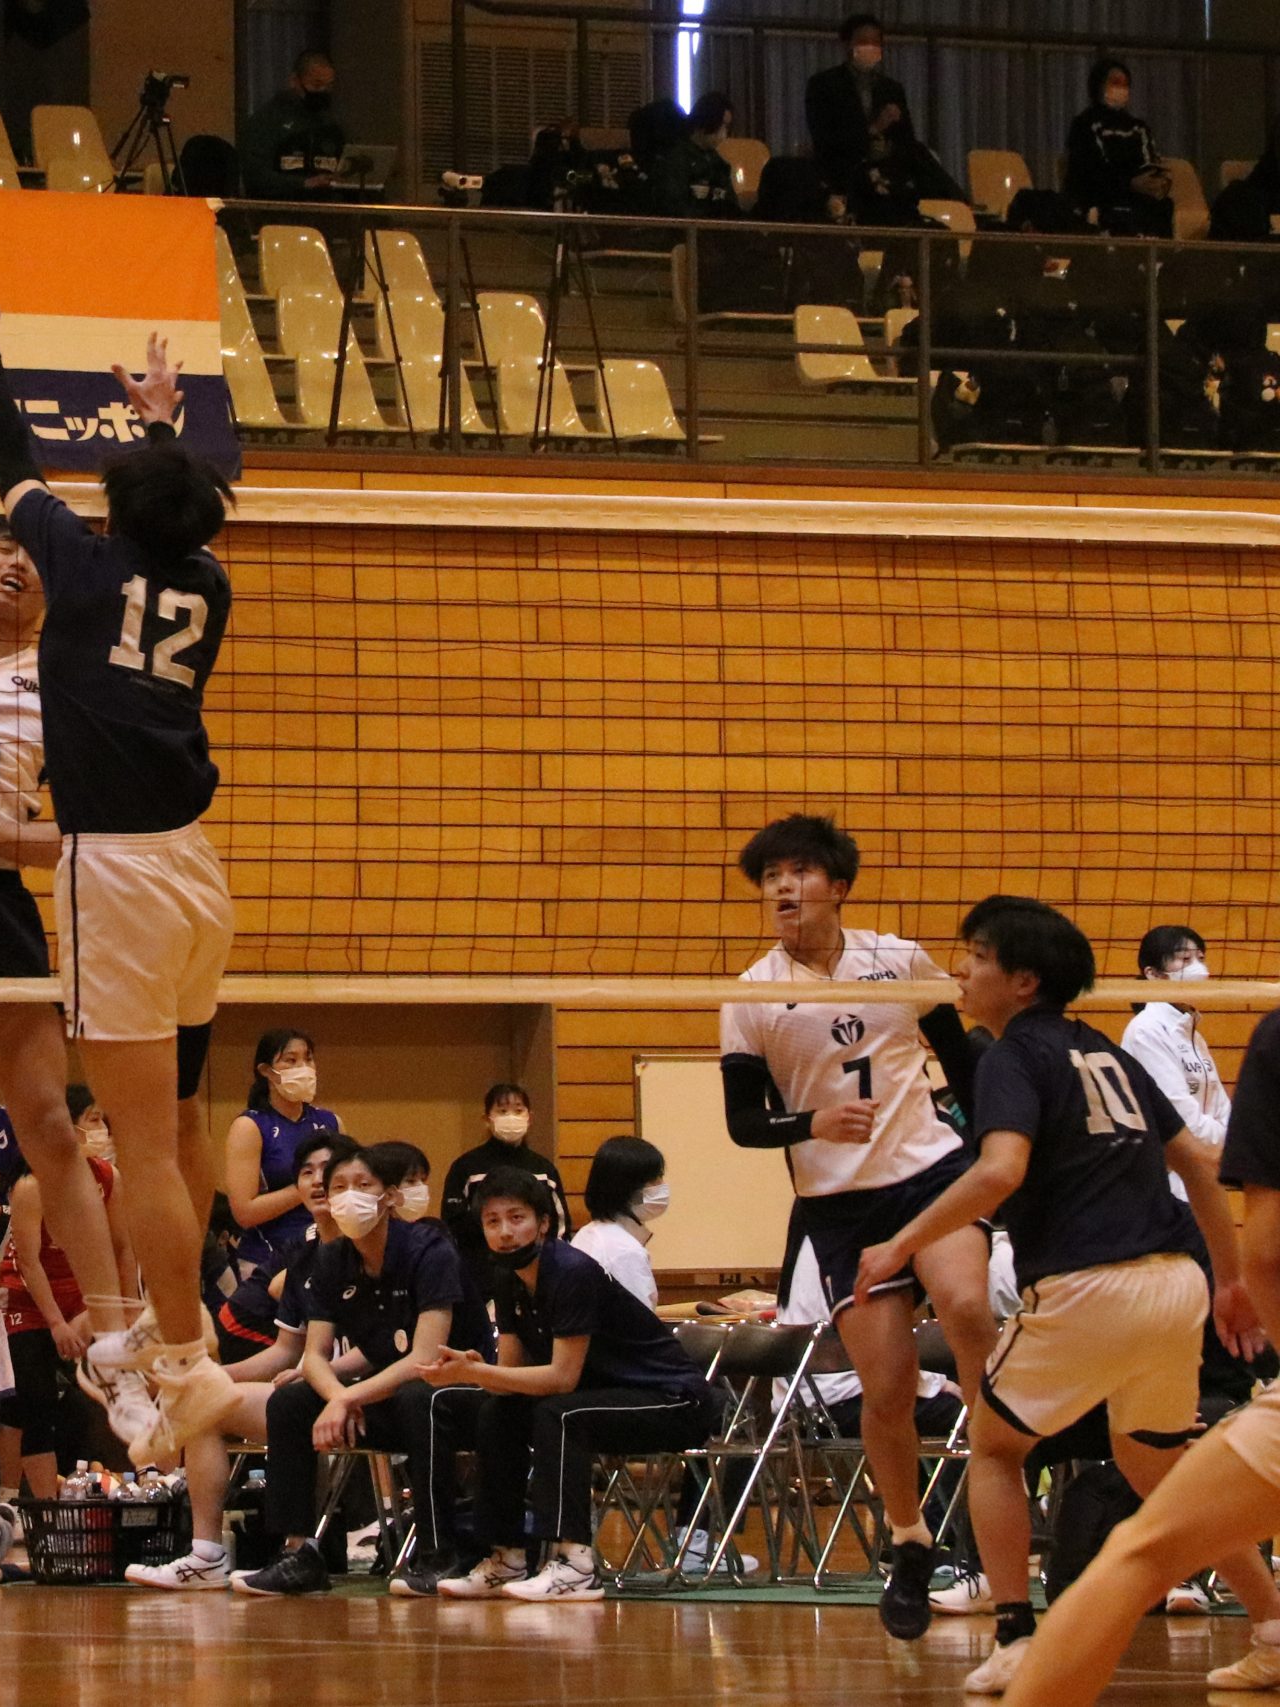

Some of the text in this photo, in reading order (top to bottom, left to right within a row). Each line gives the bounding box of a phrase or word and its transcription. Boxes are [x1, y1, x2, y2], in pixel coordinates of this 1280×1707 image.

[108, 574, 208, 689] 12
[1069, 1049, 1148, 1135] 10
[8, 1312, 24, 1327] 12
